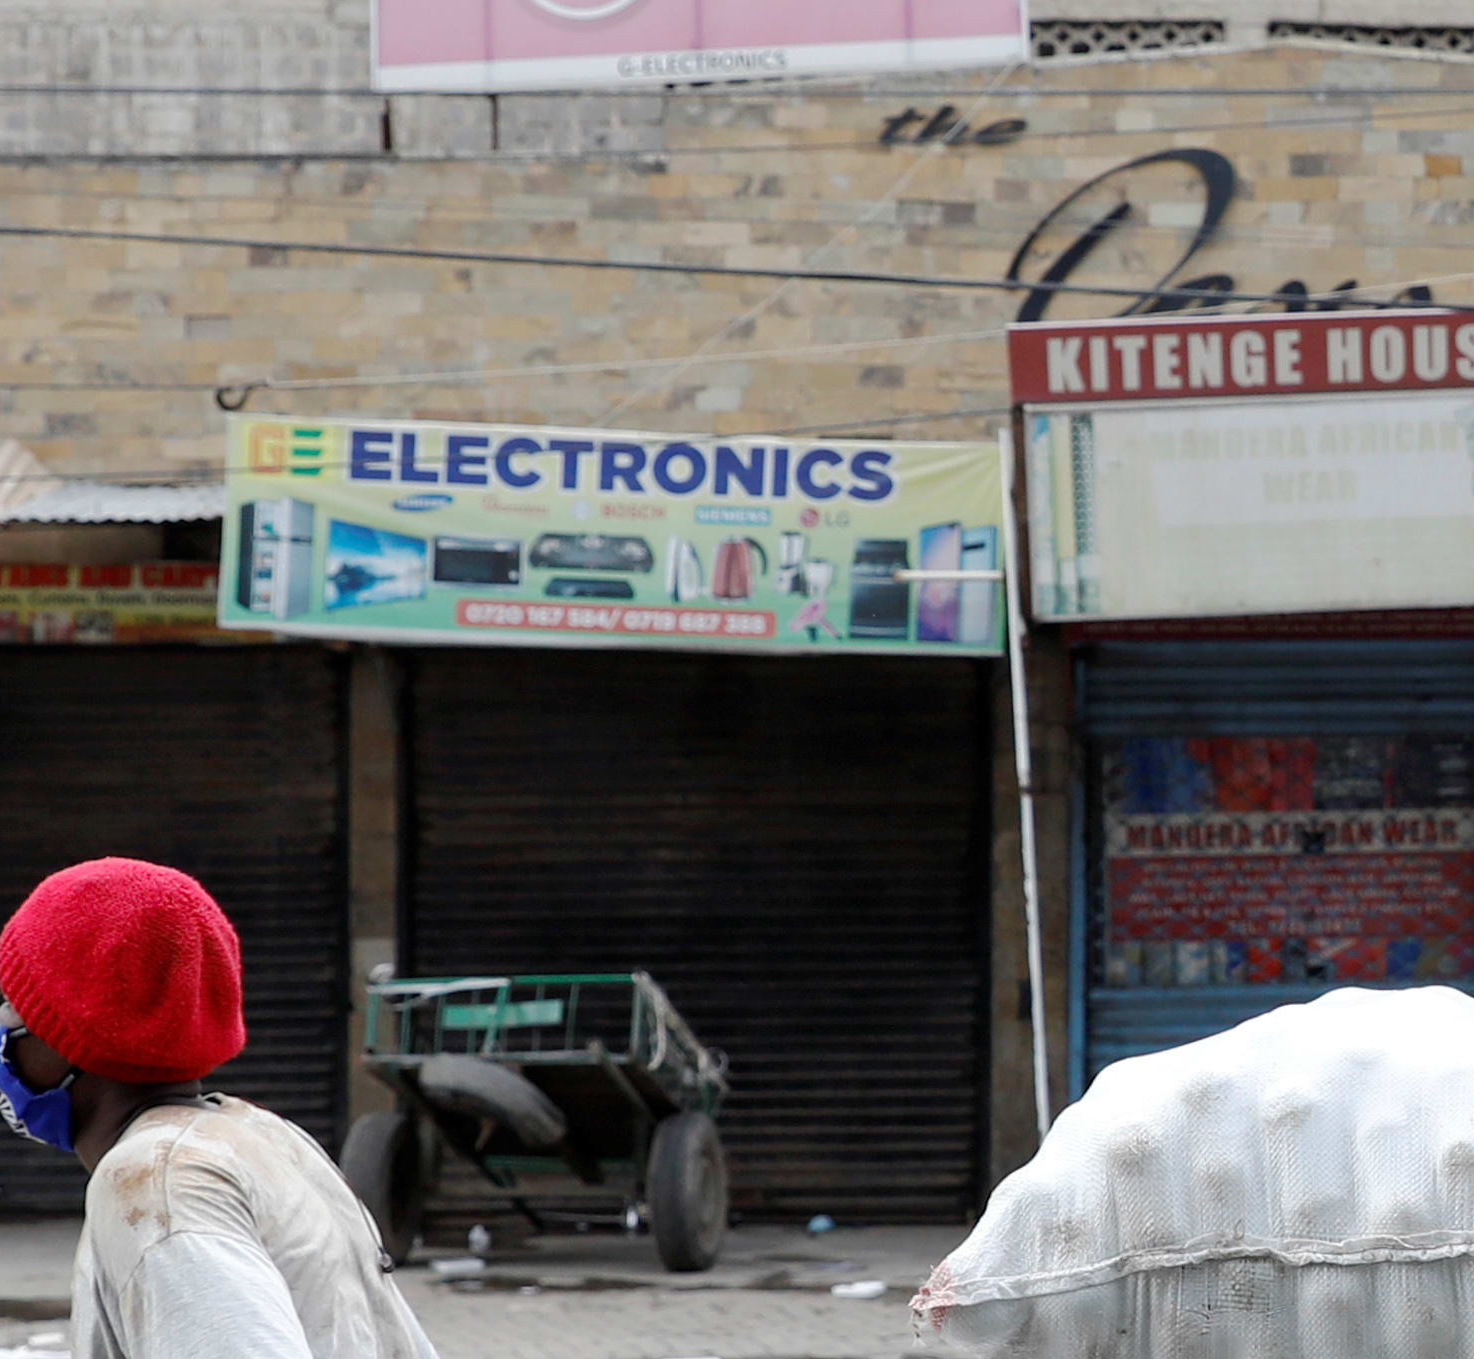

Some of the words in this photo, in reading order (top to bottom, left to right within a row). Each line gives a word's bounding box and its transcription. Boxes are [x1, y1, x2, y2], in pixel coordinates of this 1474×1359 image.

[879, 104, 1027, 147] the
[1046, 329, 1303, 394] KITENGE
[349, 429, 895, 501] ELECTRONICS
